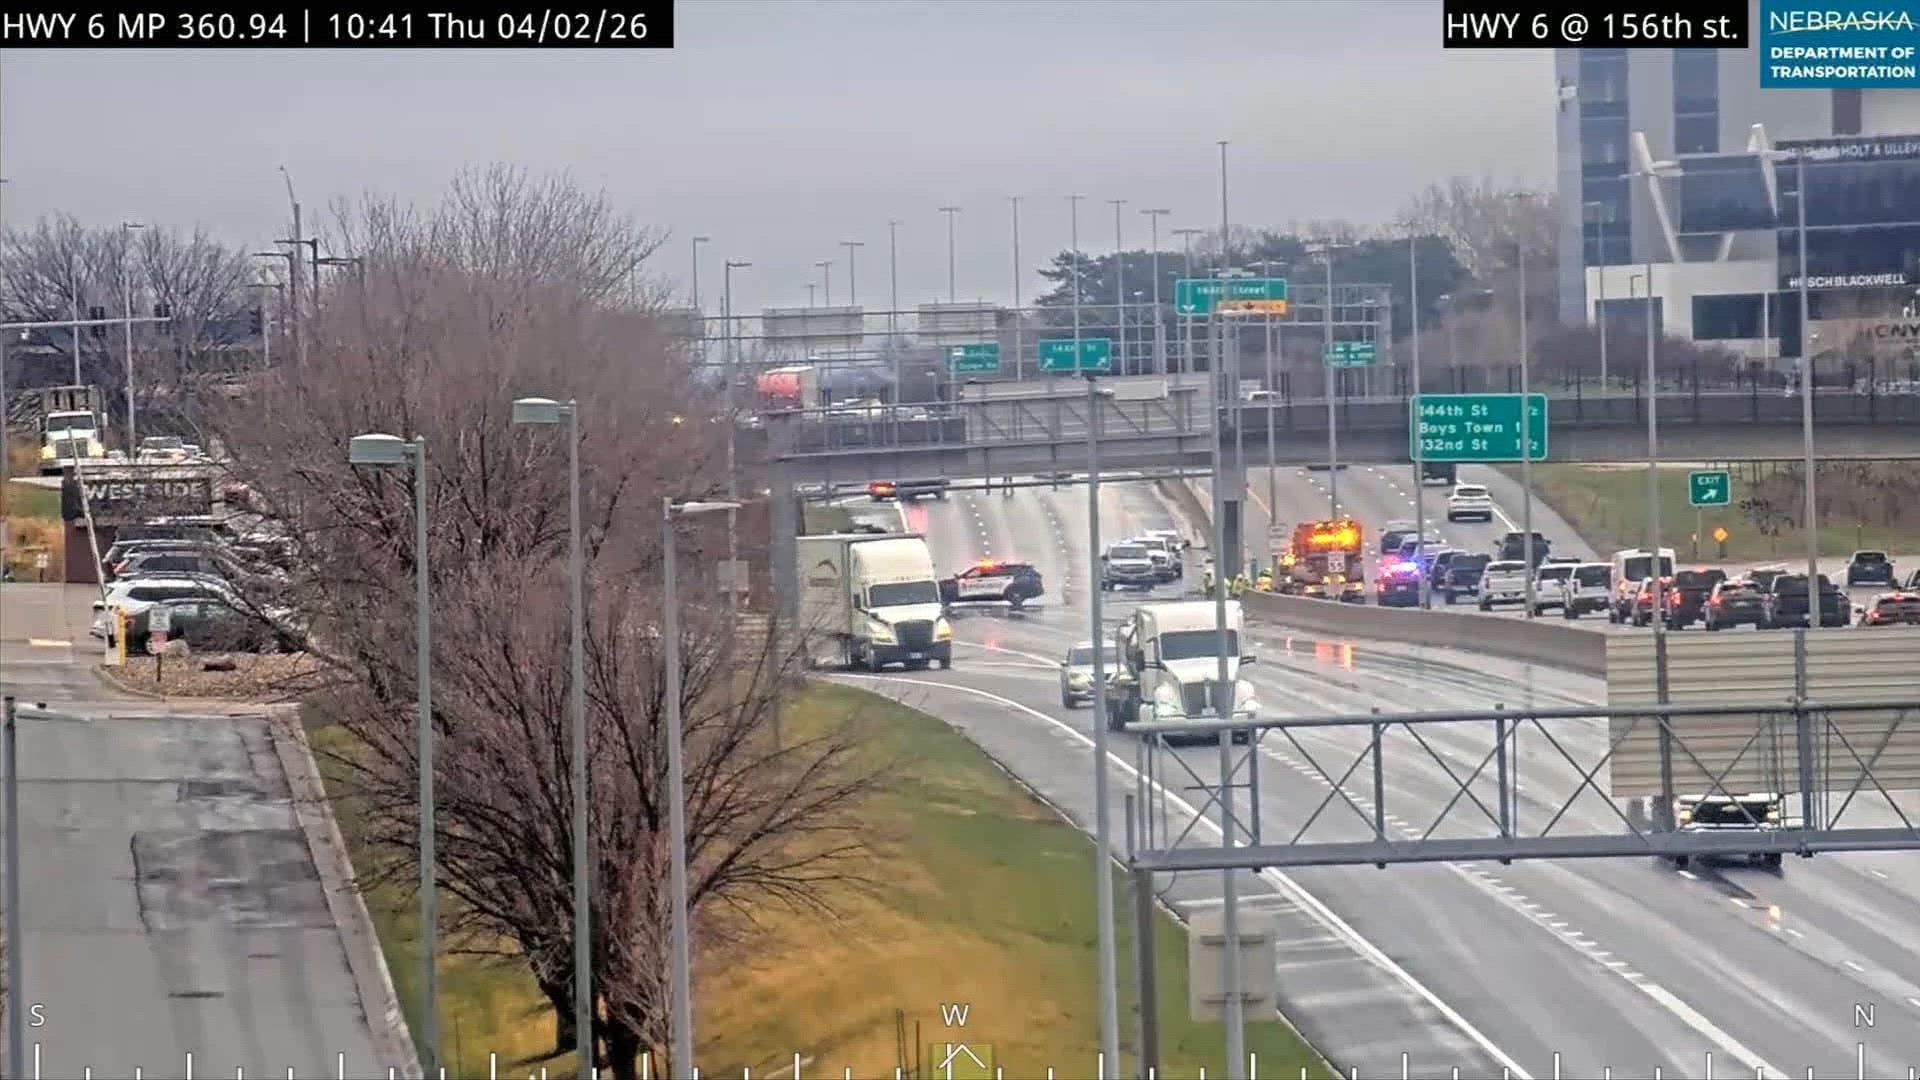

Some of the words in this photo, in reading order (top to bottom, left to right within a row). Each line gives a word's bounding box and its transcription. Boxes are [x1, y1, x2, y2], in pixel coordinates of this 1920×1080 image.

[1834, 273, 1906, 287] BLACKWELL
[1419, 404, 1463, 417] 144th
[1471, 404, 1489, 417] St
[1418, 421, 1457, 435] Boys
[1464, 421, 1504, 433] Town
[1419, 438, 1464, 451] 132nd
[1471, 438, 1488, 451] St
